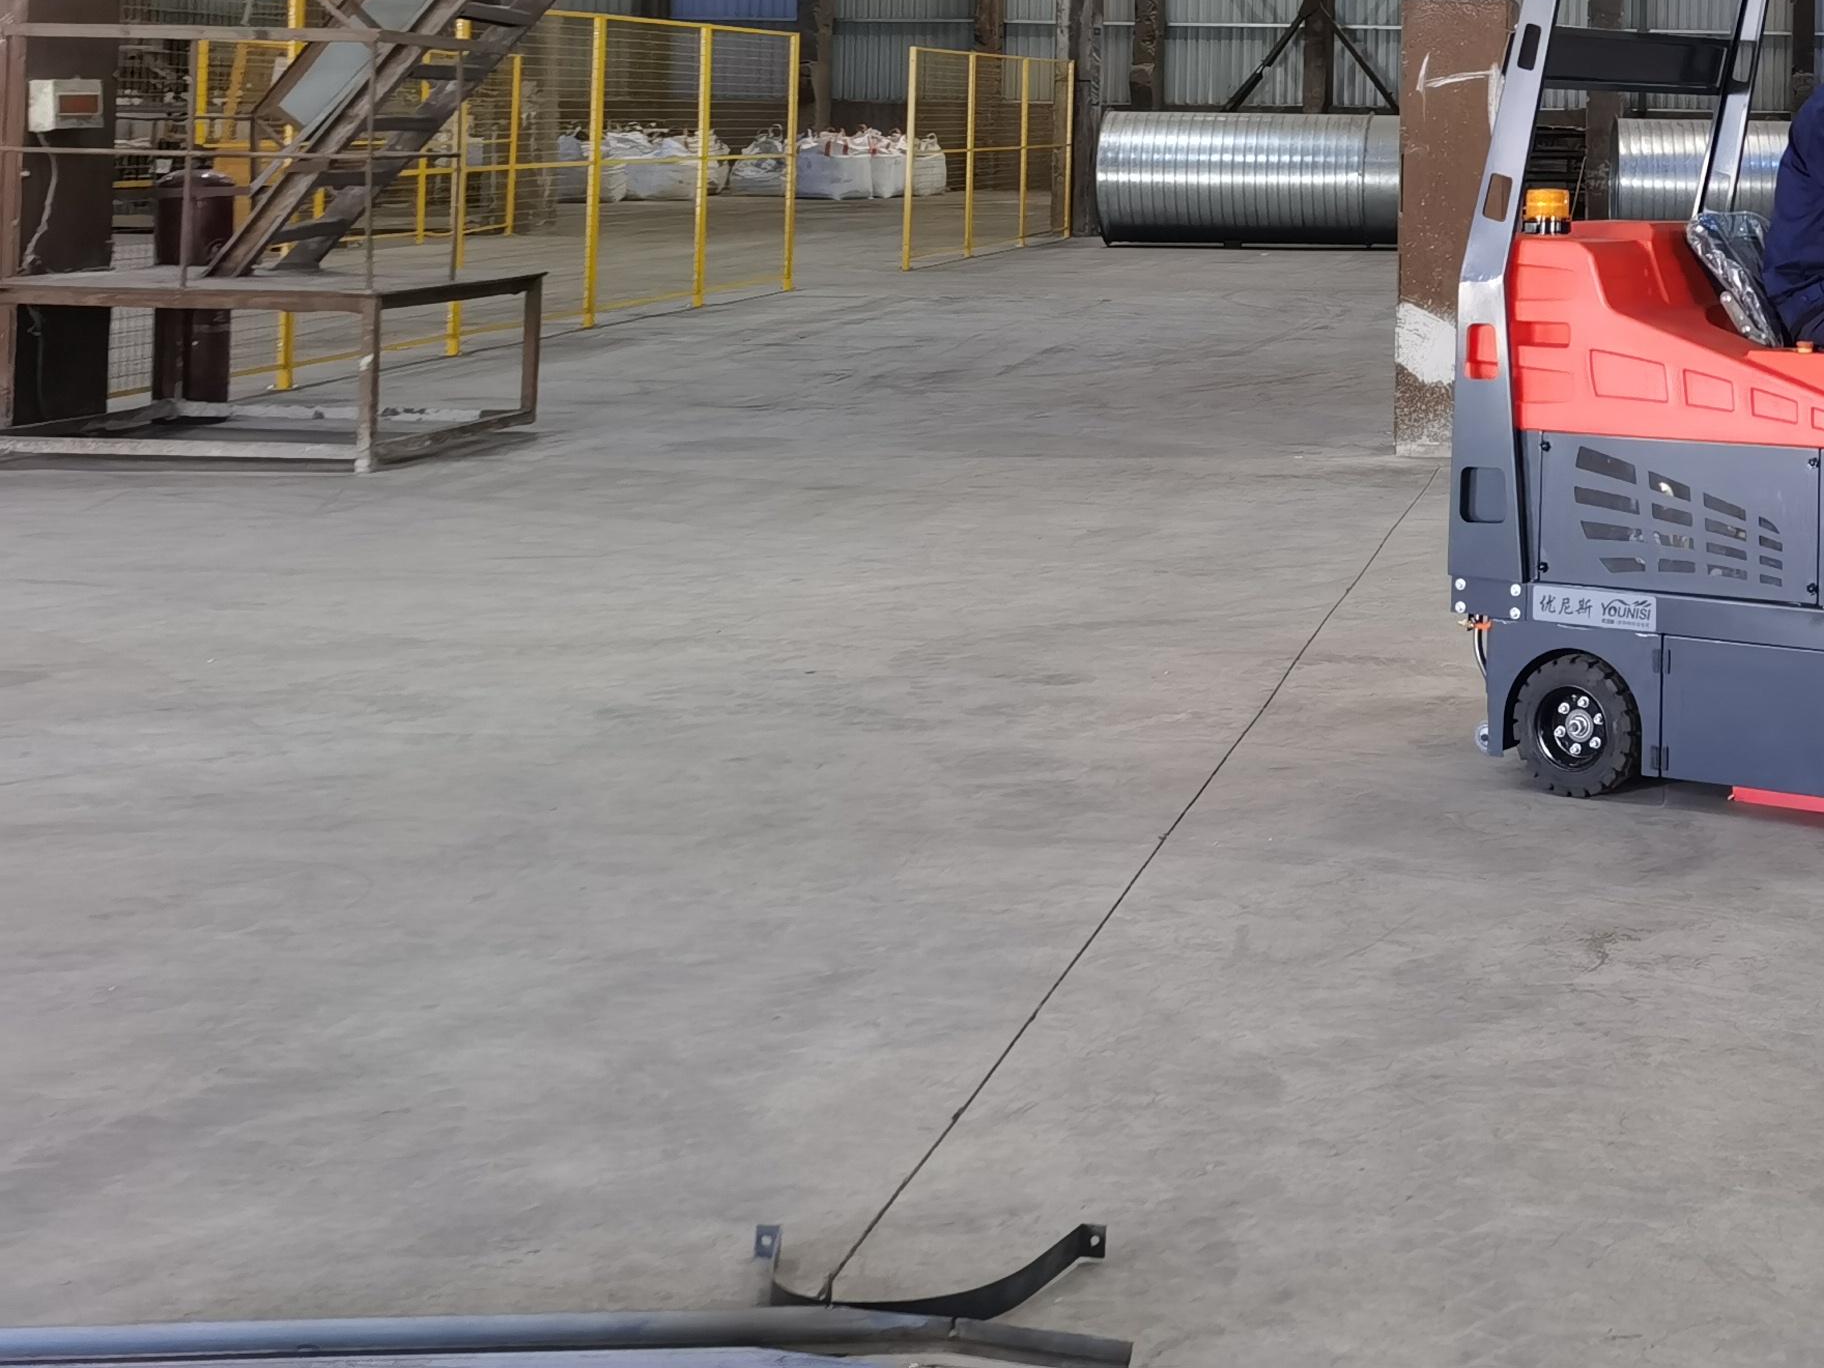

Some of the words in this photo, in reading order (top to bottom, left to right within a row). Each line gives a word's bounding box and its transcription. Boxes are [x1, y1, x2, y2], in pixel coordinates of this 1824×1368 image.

[1540, 594, 1593, 618] 优尼斯
[1601, 599, 1652, 621] YOUNISI
